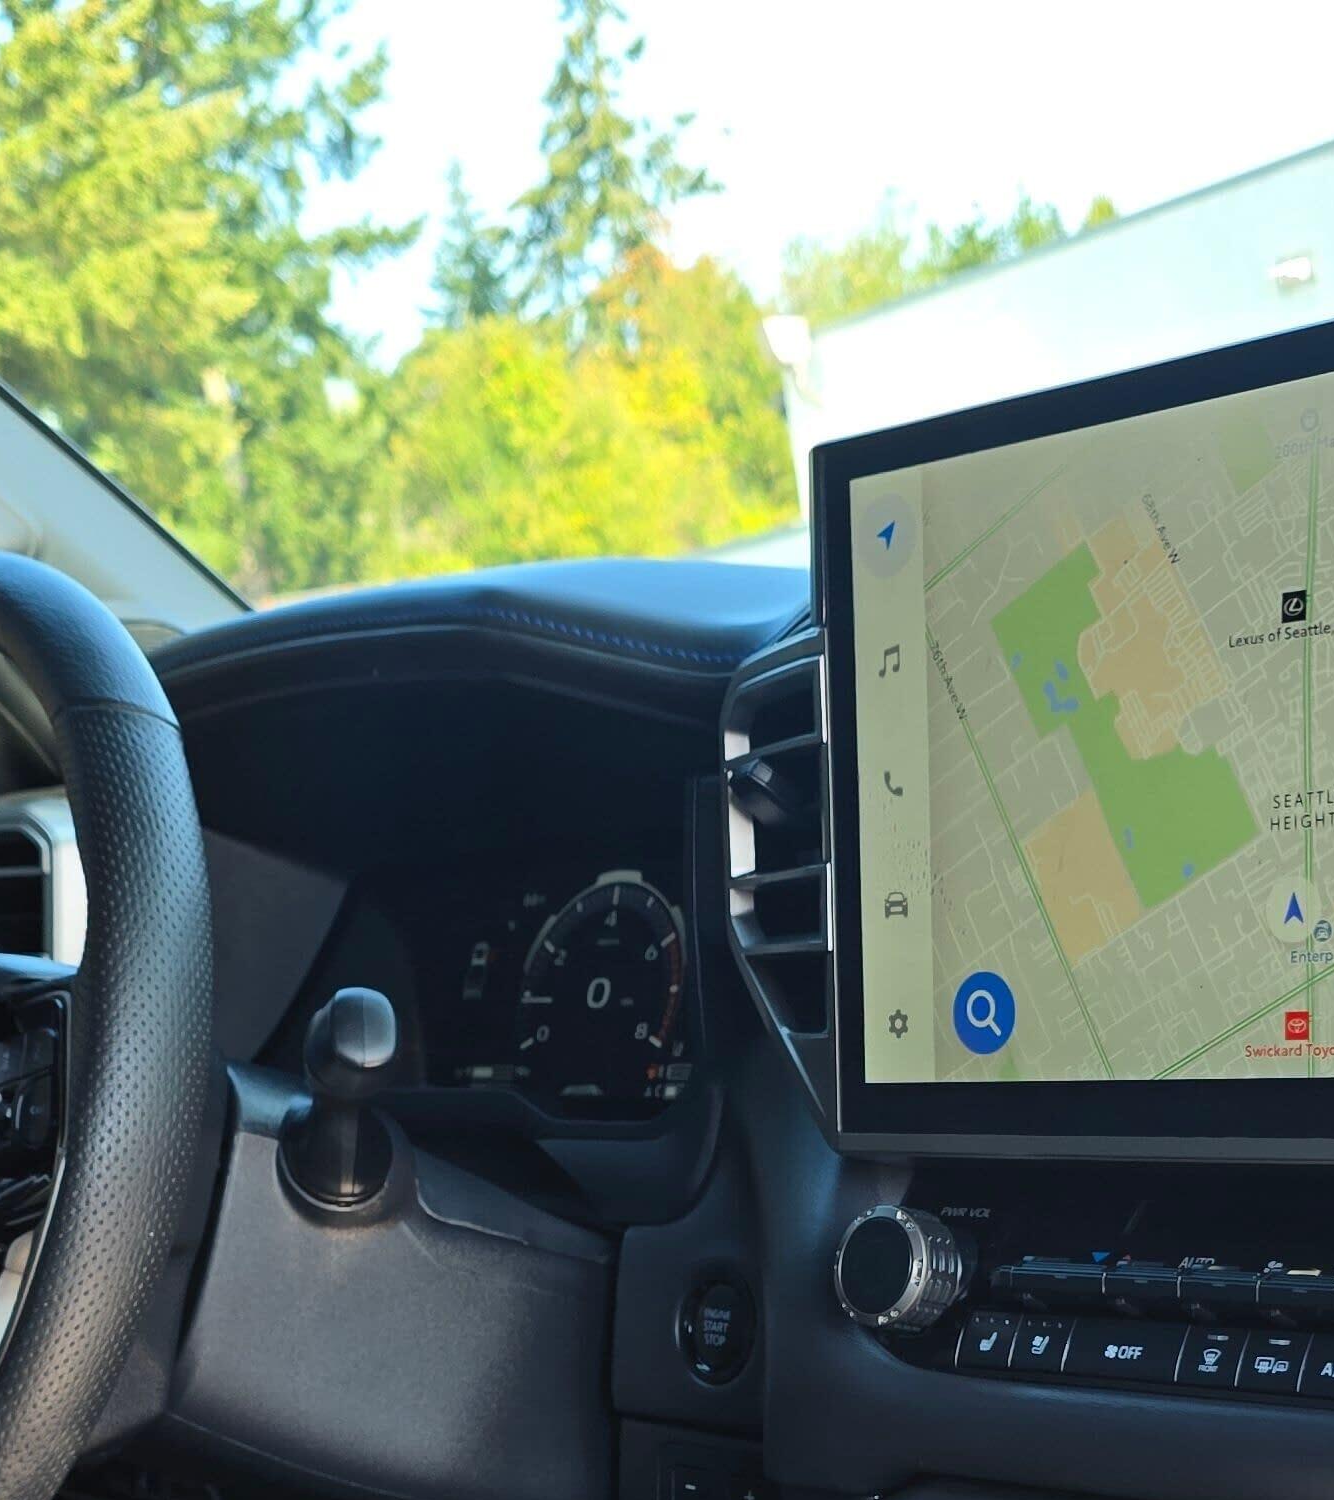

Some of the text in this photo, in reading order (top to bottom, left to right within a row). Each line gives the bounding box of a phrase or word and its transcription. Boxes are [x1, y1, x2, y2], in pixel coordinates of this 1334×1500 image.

[1168, 548, 1180, 564] W
[1228, 632, 1264, 648] Lexus
[1268, 628, 1281, 642] of
[1284, 624, 1334, 641] Seattle,
[955, 702, 968, 720] W
[644, 943, 658, 961] 6
[586, 977, 611, 1009] 0
[536, 1025, 550, 1042] 0
[634, 1022, 648, 1040] 8
[1244, 1042, 1303, 1058] Swickard
[703, 1320, 729, 1333] START
[704, 1333, 727, 1347] STOP
[1117, 1345, 1144, 1360] OFF
